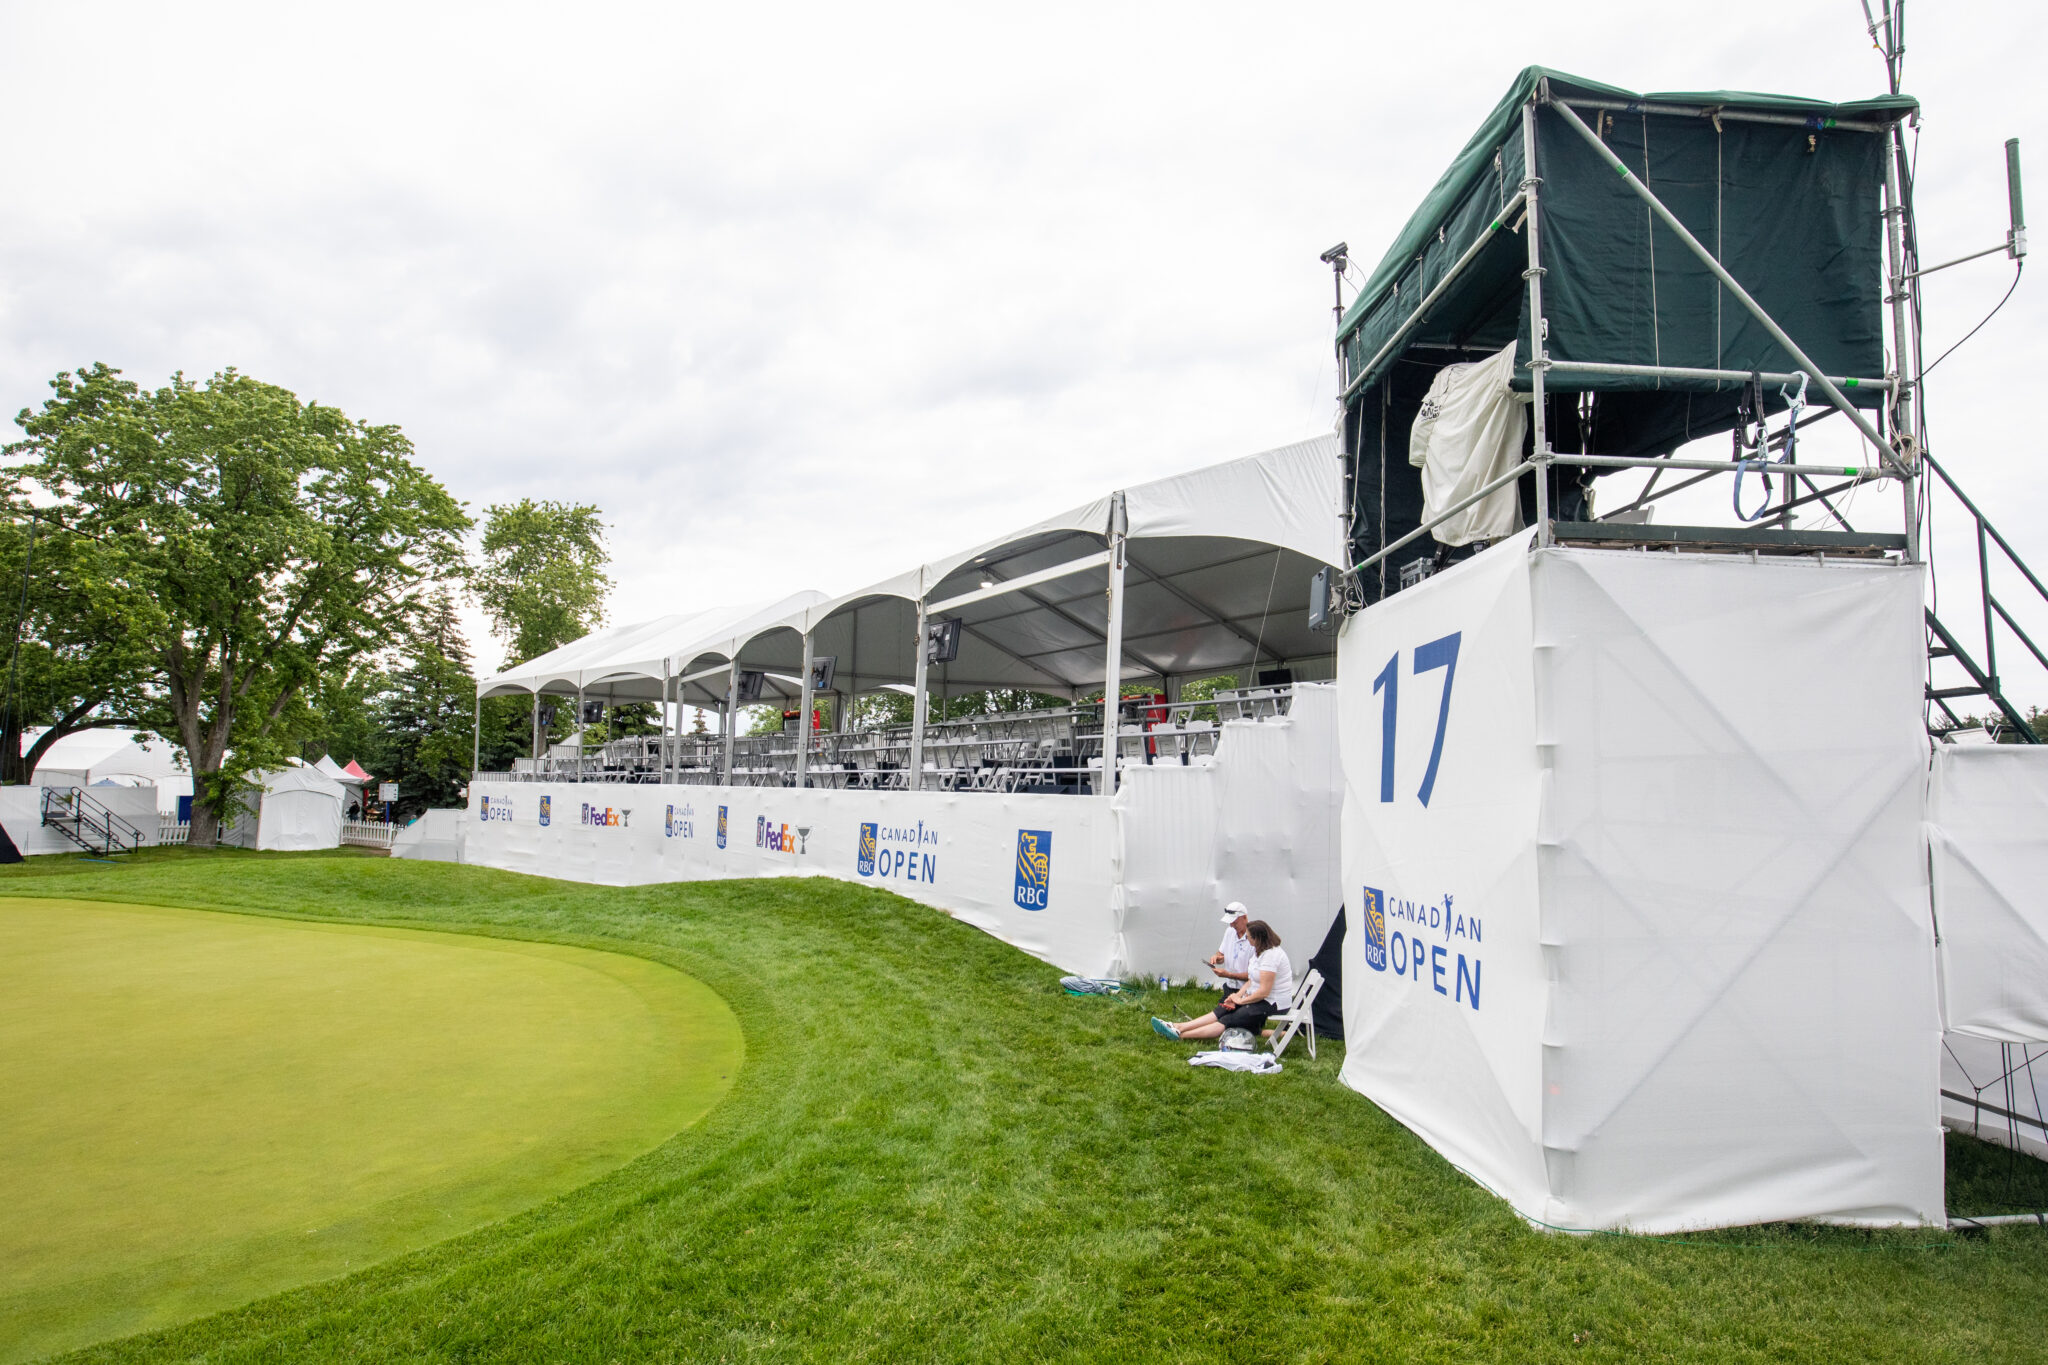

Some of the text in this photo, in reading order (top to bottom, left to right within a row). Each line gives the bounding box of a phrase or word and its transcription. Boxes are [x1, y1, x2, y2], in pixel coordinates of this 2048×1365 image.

[1373, 631, 1462, 808] 17
[489, 807, 513, 821] OPEN
[590, 806, 620, 827] FedEx
[673, 819, 693, 838] OPEN
[765, 821, 796, 854] FedEx
[858, 860, 874, 874] RBC
[878, 848, 936, 884] OPEN
[1017, 885, 1046, 907] RBC
[1366, 943, 1385, 968] RBC
[1391, 930, 1481, 1011] OPEN
